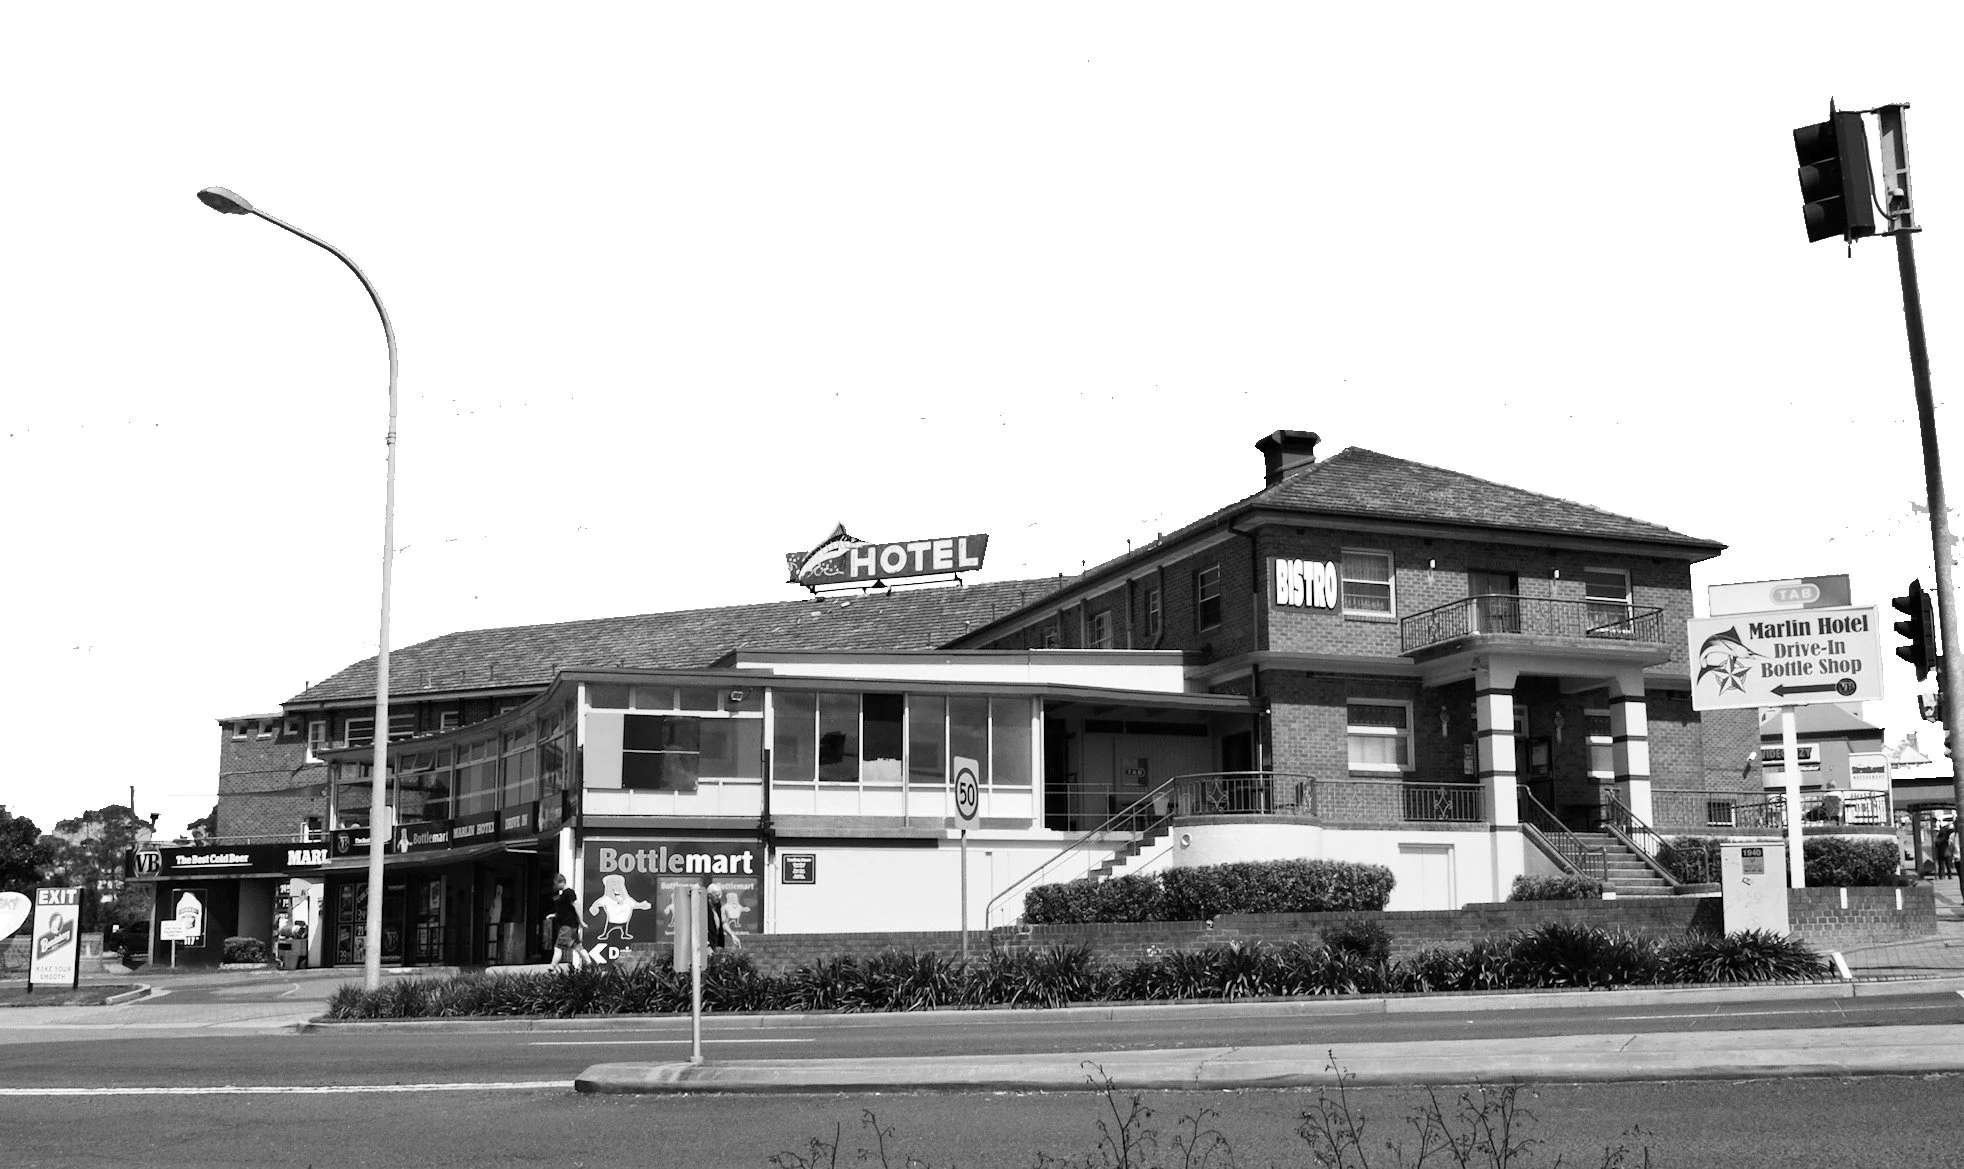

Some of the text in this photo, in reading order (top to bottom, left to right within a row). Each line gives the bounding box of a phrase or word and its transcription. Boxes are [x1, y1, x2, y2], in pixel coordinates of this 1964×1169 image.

[850, 538, 979, 577] HOTEL
[1275, 559, 1338, 610] BISTRO
[1778, 588, 1812, 600] TAB
[1749, 615, 1869, 640] Marlin Hotel
[1774, 640, 1846, 659] Drive-In
[1761, 657, 1862, 679] Bottle Shop
[960, 782, 975, 806] 50
[413, 831, 449, 845] Bottlemart
[176, 853, 249, 865] The Best Cold Beer
[600, 846, 753, 874] Bottlemart
[39, 889, 77, 905] EXIT
